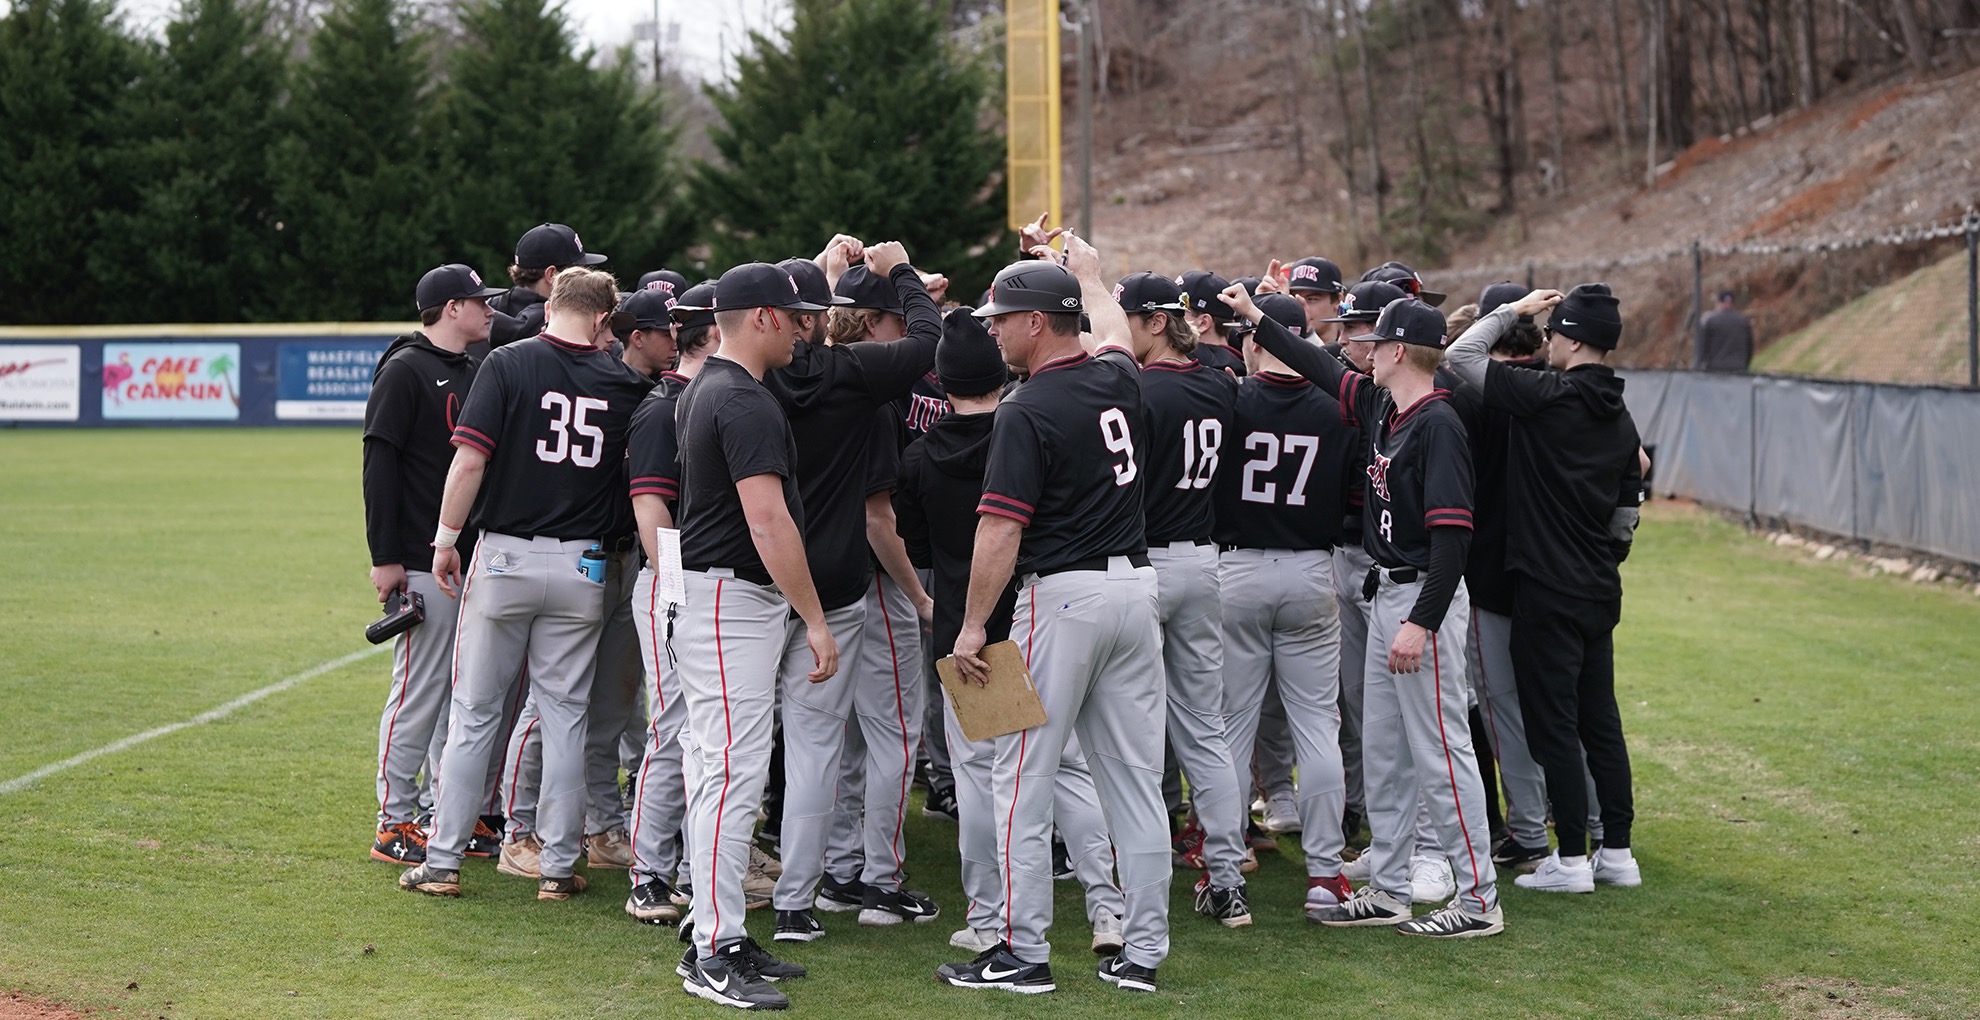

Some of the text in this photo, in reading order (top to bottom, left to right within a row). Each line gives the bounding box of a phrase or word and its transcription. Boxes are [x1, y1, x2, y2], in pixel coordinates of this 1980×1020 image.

[141, 357, 204, 375] CAFE
[306, 366, 369, 380] BEASLEY
[126, 382, 224, 401] CANCUN
[306, 382, 373, 396] ASSOCIAT
[535, 391, 608, 468] 35
[1099, 407, 1137, 486] 9
[1174, 418, 1222, 489] 18
[1241, 431, 1320, 506] 27
